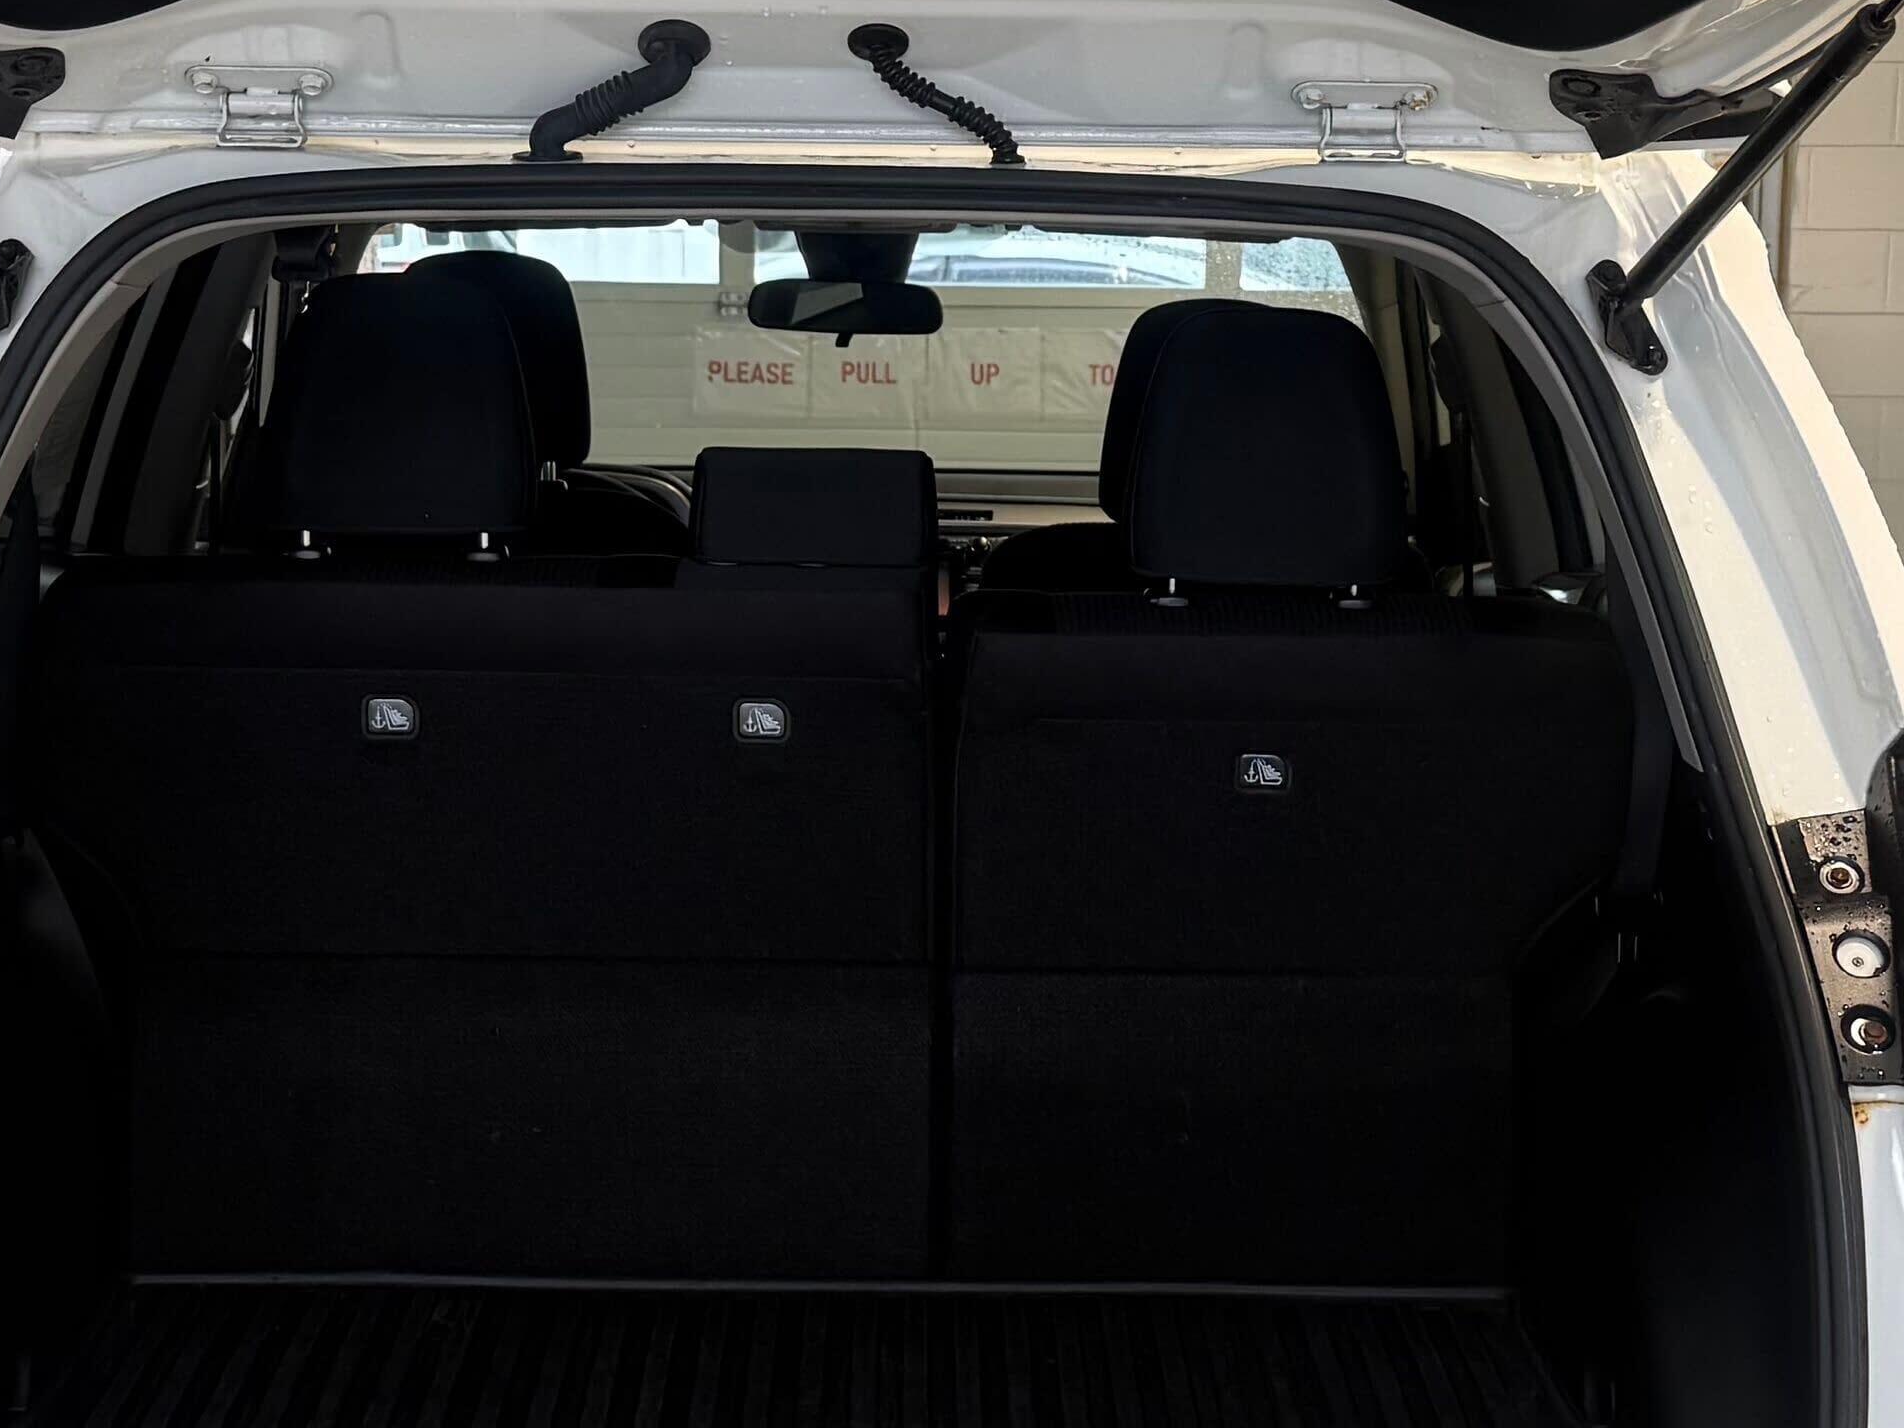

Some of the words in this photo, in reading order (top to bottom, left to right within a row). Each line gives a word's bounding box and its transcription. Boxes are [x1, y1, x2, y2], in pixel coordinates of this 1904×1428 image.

[708, 360, 794, 385] PLEASE
[841, 361, 897, 385] PULL
[969, 363, 1001, 385] UP
[1088, 364, 1115, 386] TO
